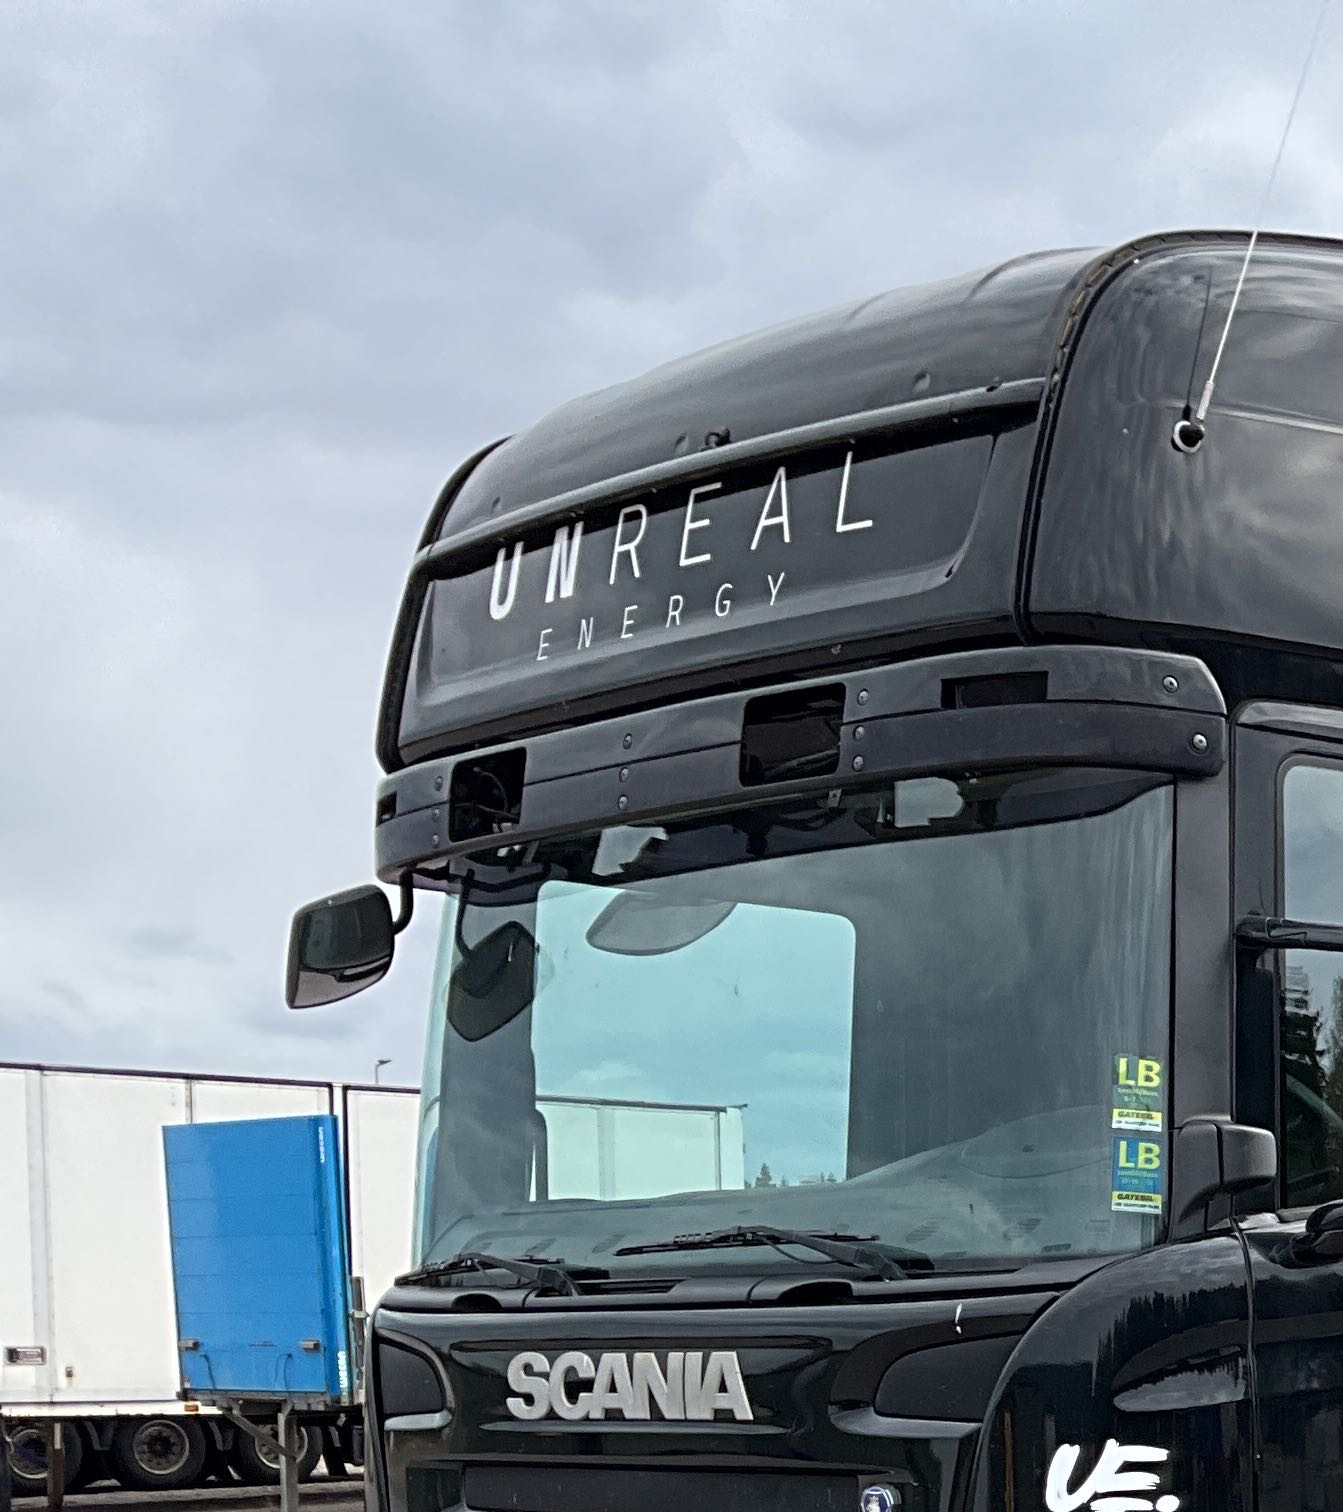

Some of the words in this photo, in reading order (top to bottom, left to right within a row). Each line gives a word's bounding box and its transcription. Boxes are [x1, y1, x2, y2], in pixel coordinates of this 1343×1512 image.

[489, 451, 874, 620] UNREAL
[536, 571, 786, 661] ENERGY
[1118, 1057, 1161, 1088] LB
[1118, 1140, 1161, 1170] LB
[506, 1351, 754, 1421] SCANIA
